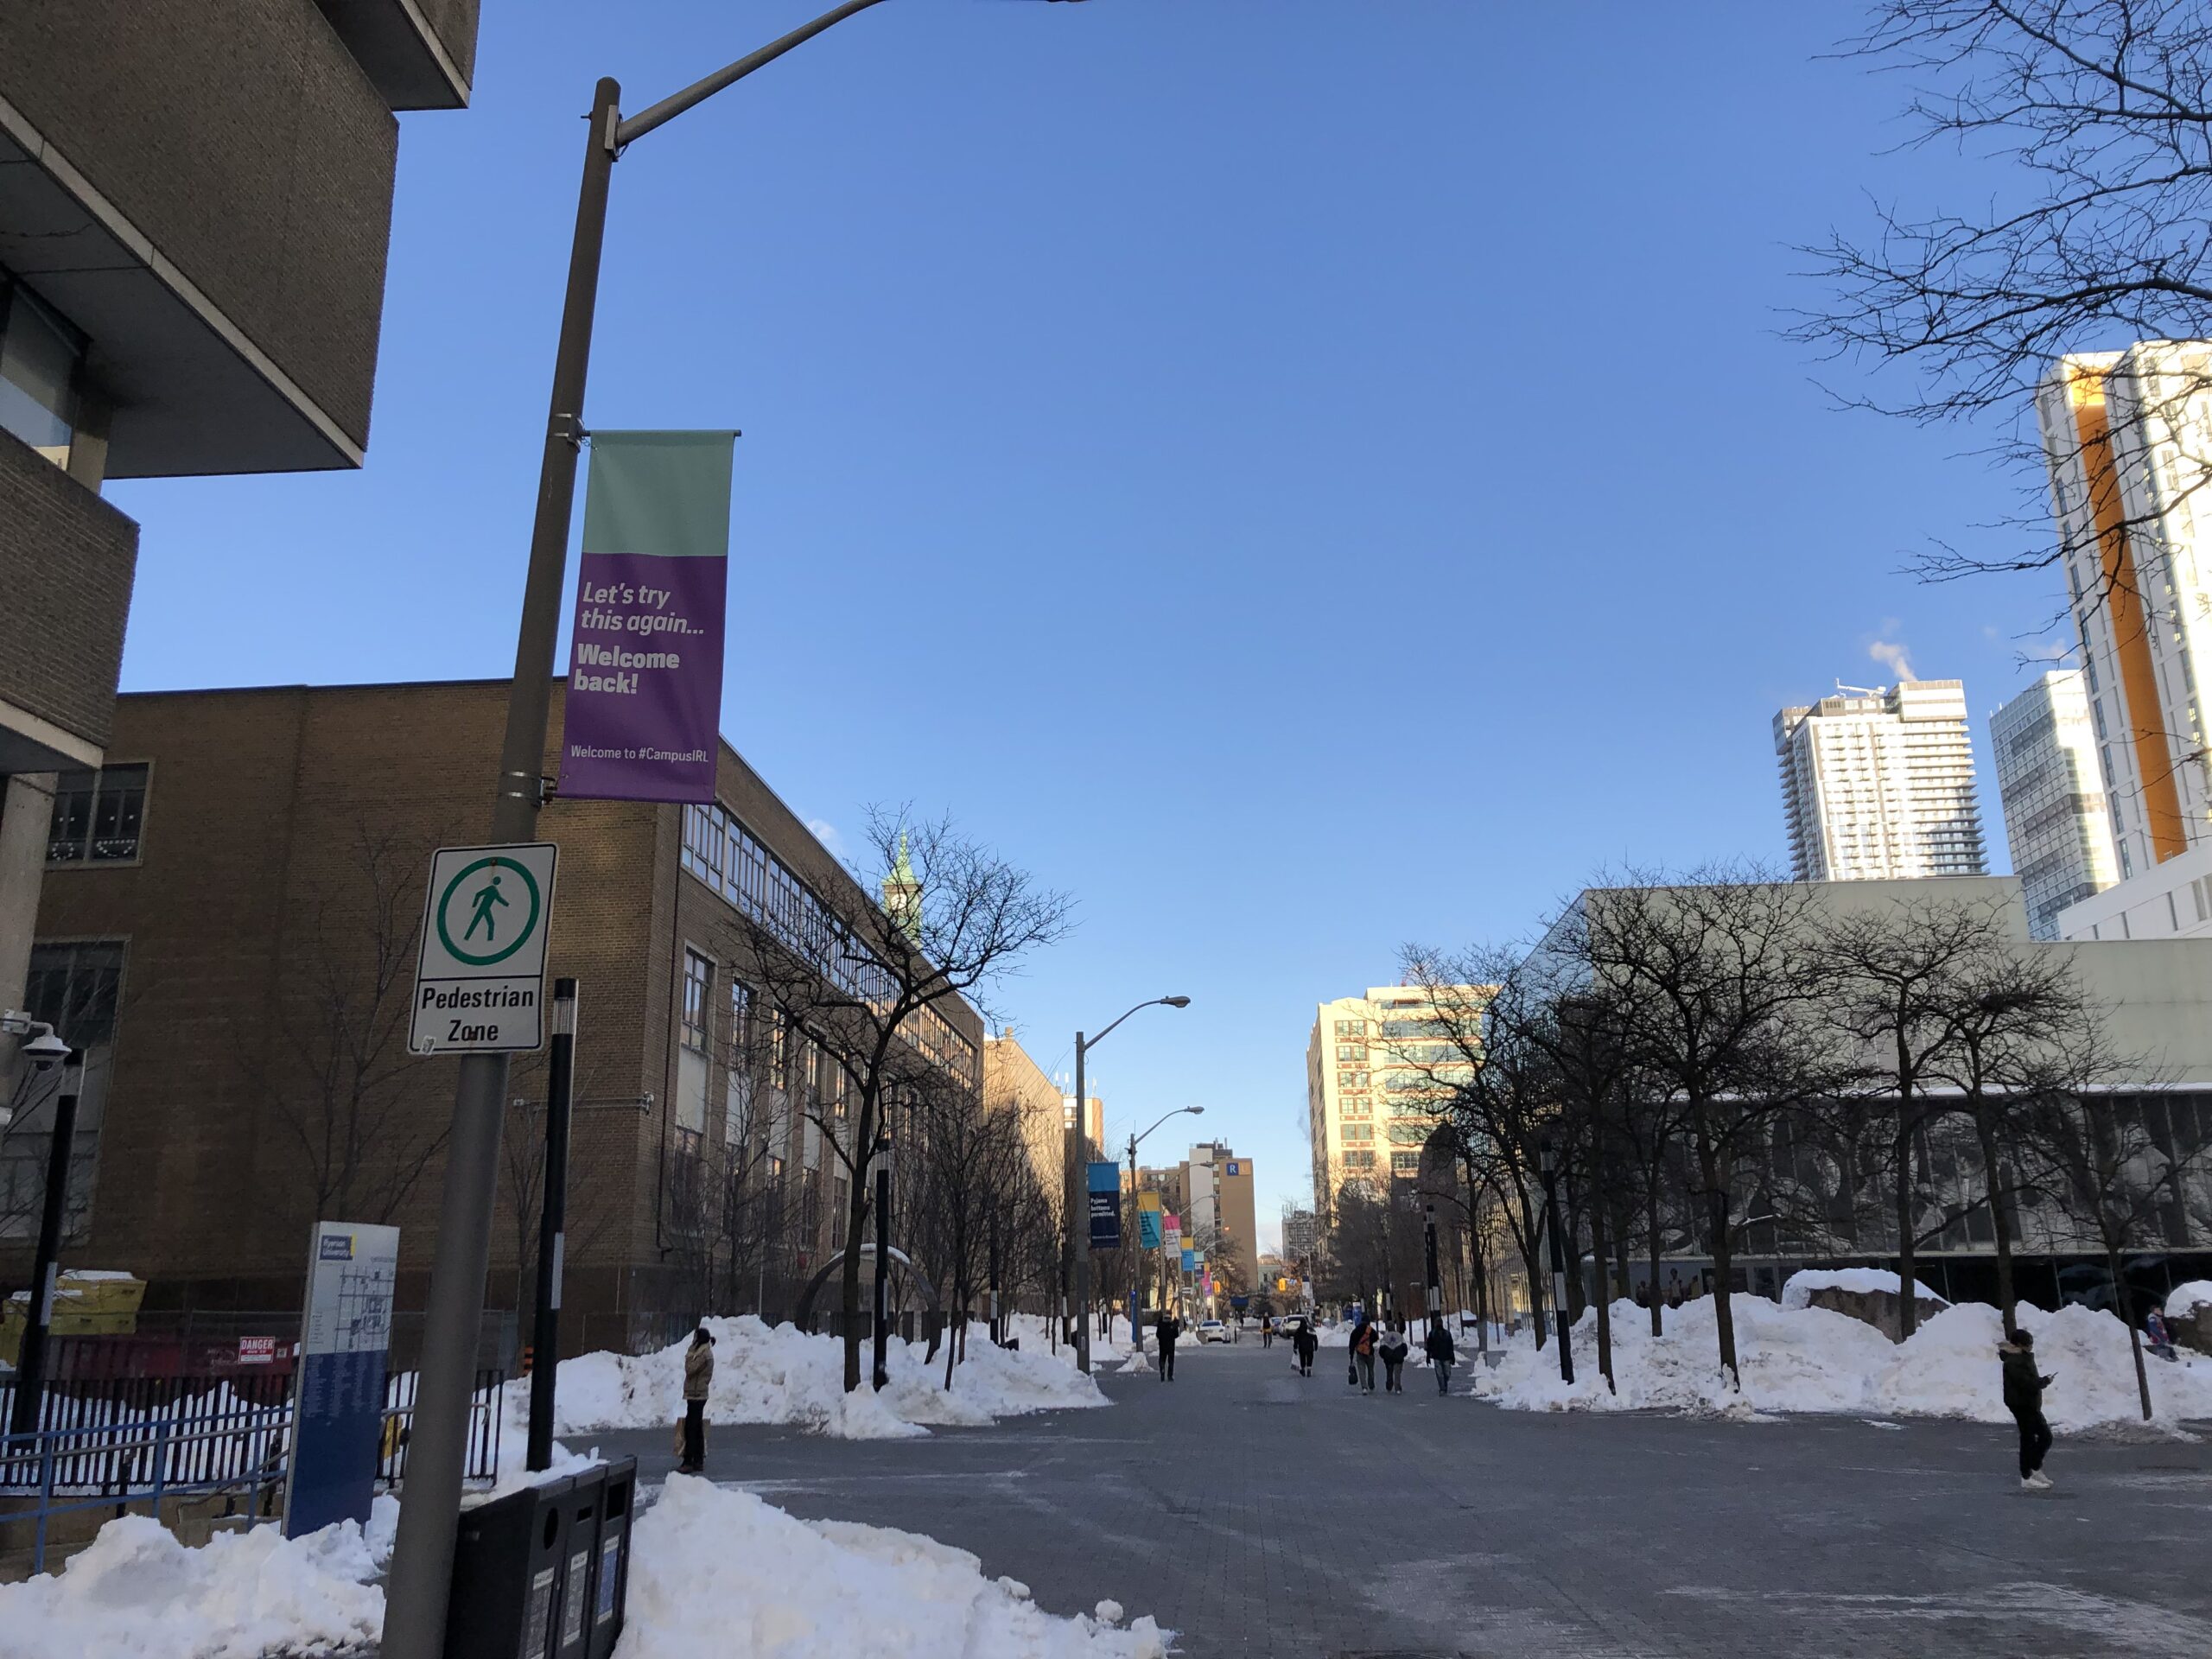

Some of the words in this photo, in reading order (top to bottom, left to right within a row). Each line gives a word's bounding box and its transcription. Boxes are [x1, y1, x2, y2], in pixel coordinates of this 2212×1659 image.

[582, 582, 634, 604] Let's
[639, 585, 671, 609] try
[581, 607, 623, 630] this
[626, 612, 704, 636] again...
[577, 643, 680, 669] Welcome
[574, 668, 639, 694] back!
[571, 745, 622, 759] Welcome
[624, 747, 636, 759] to
[639, 747, 709, 764] #CampusIRL
[422, 985, 533, 1009] Pedestrian
[448, 1020, 499, 1041] Zone
[241, 1339, 273, 1350] DANGER
